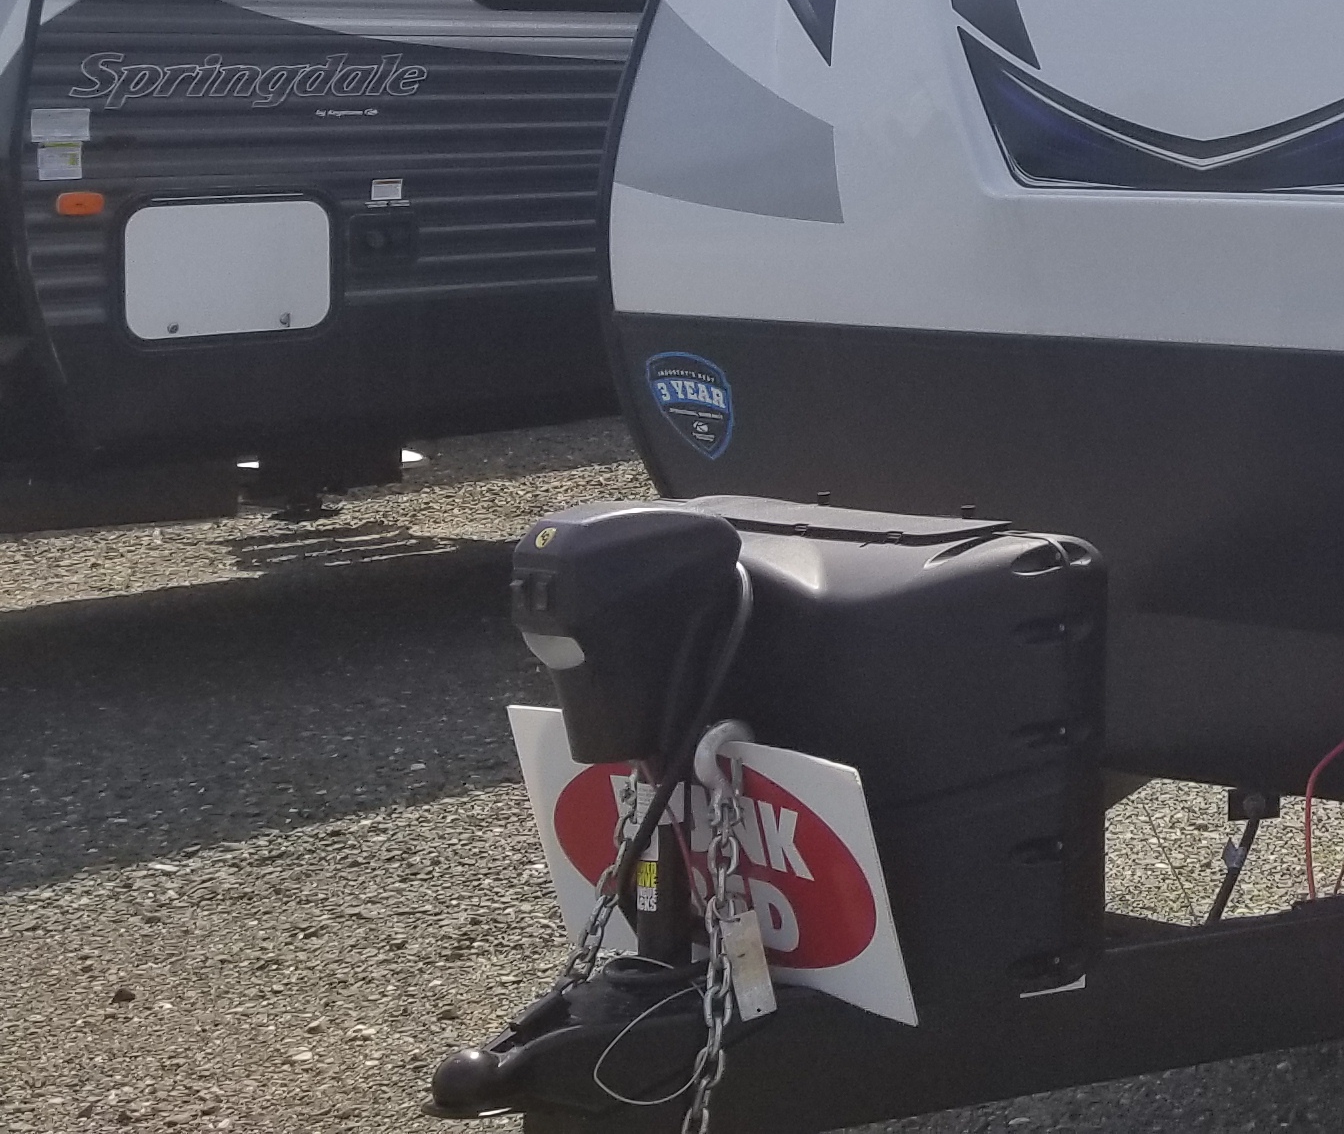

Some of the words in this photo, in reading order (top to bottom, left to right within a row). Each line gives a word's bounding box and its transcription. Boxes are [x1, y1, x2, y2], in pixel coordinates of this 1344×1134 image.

[68, 51, 428, 110] Springdale
[657, 382, 671, 401] 3
[670, 380, 726, 409] YEAR
